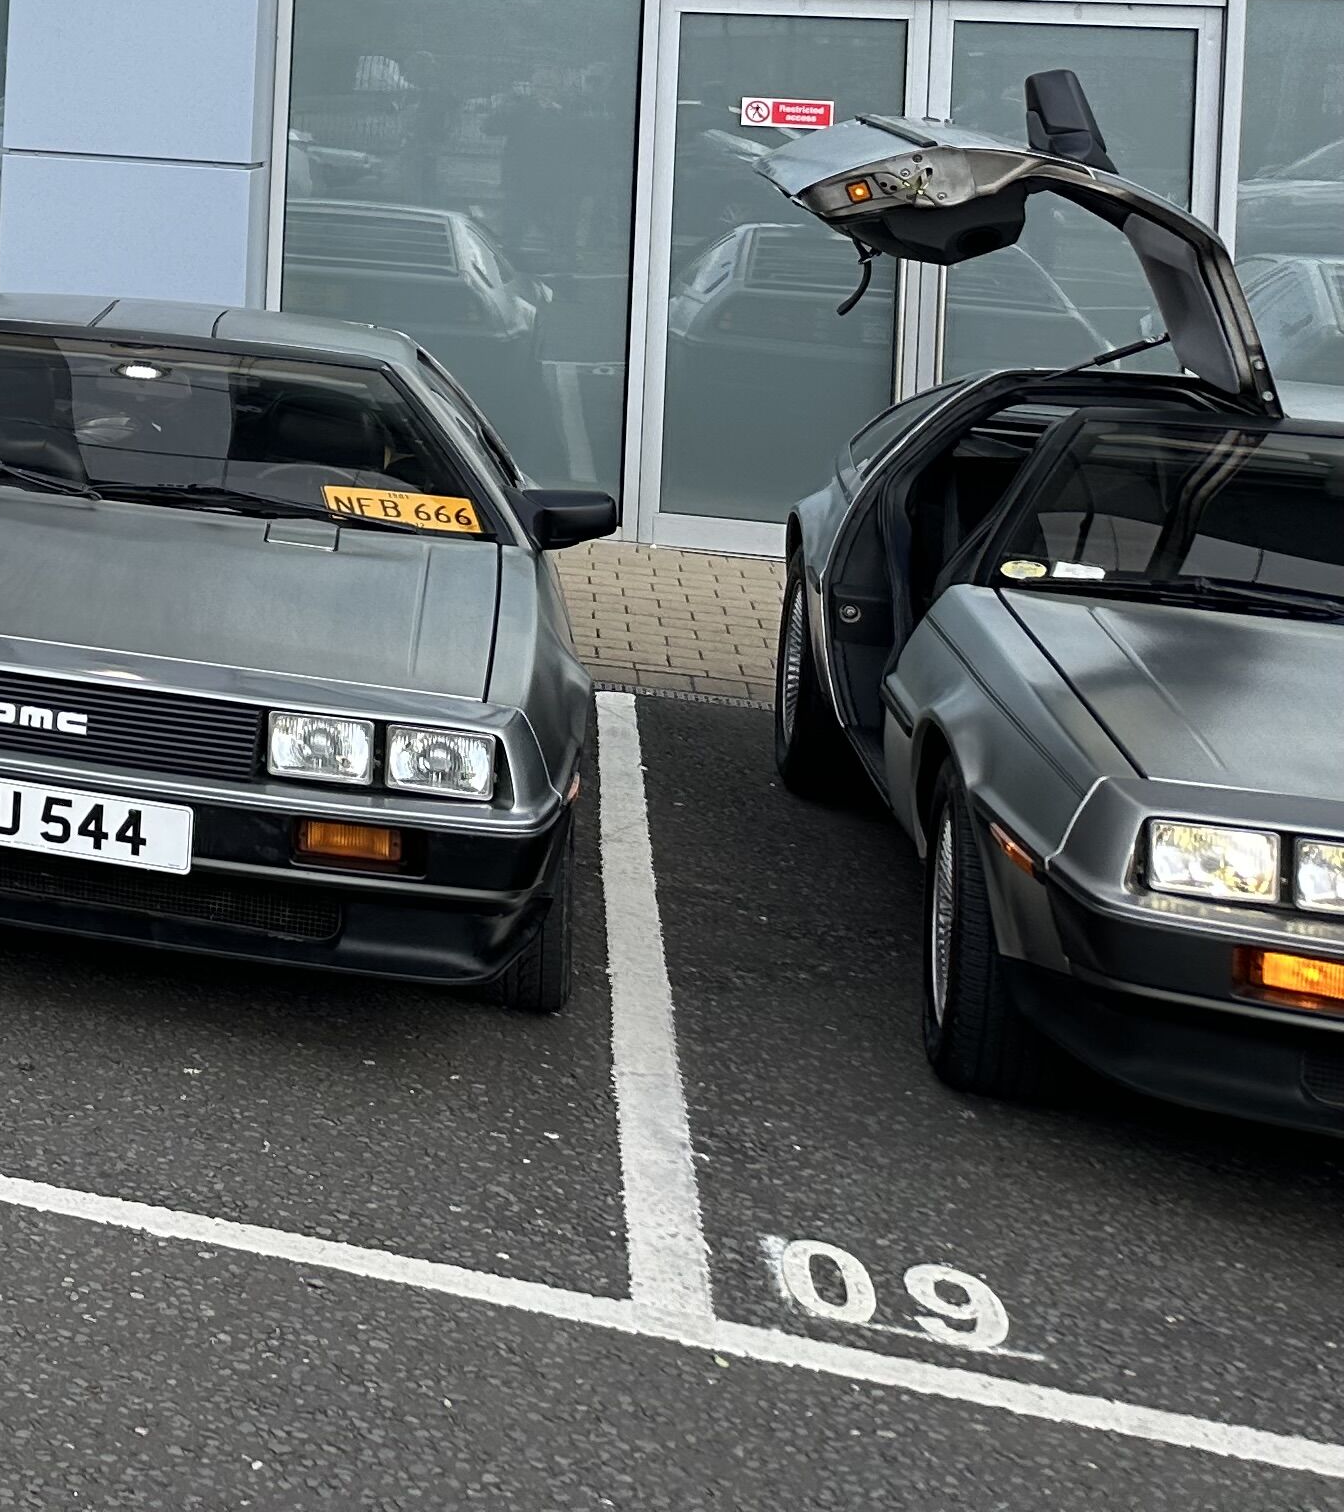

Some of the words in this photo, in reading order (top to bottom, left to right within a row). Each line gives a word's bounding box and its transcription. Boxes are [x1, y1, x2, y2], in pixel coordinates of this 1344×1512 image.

[778, 104, 825, 115] Restricted
[785, 115, 817, 123] access
[333, 495, 402, 518] NFB
[414, 503, 473, 526] 666
[39, 795, 147, 857] 544
[780, 1239, 1010, 1348] 09
